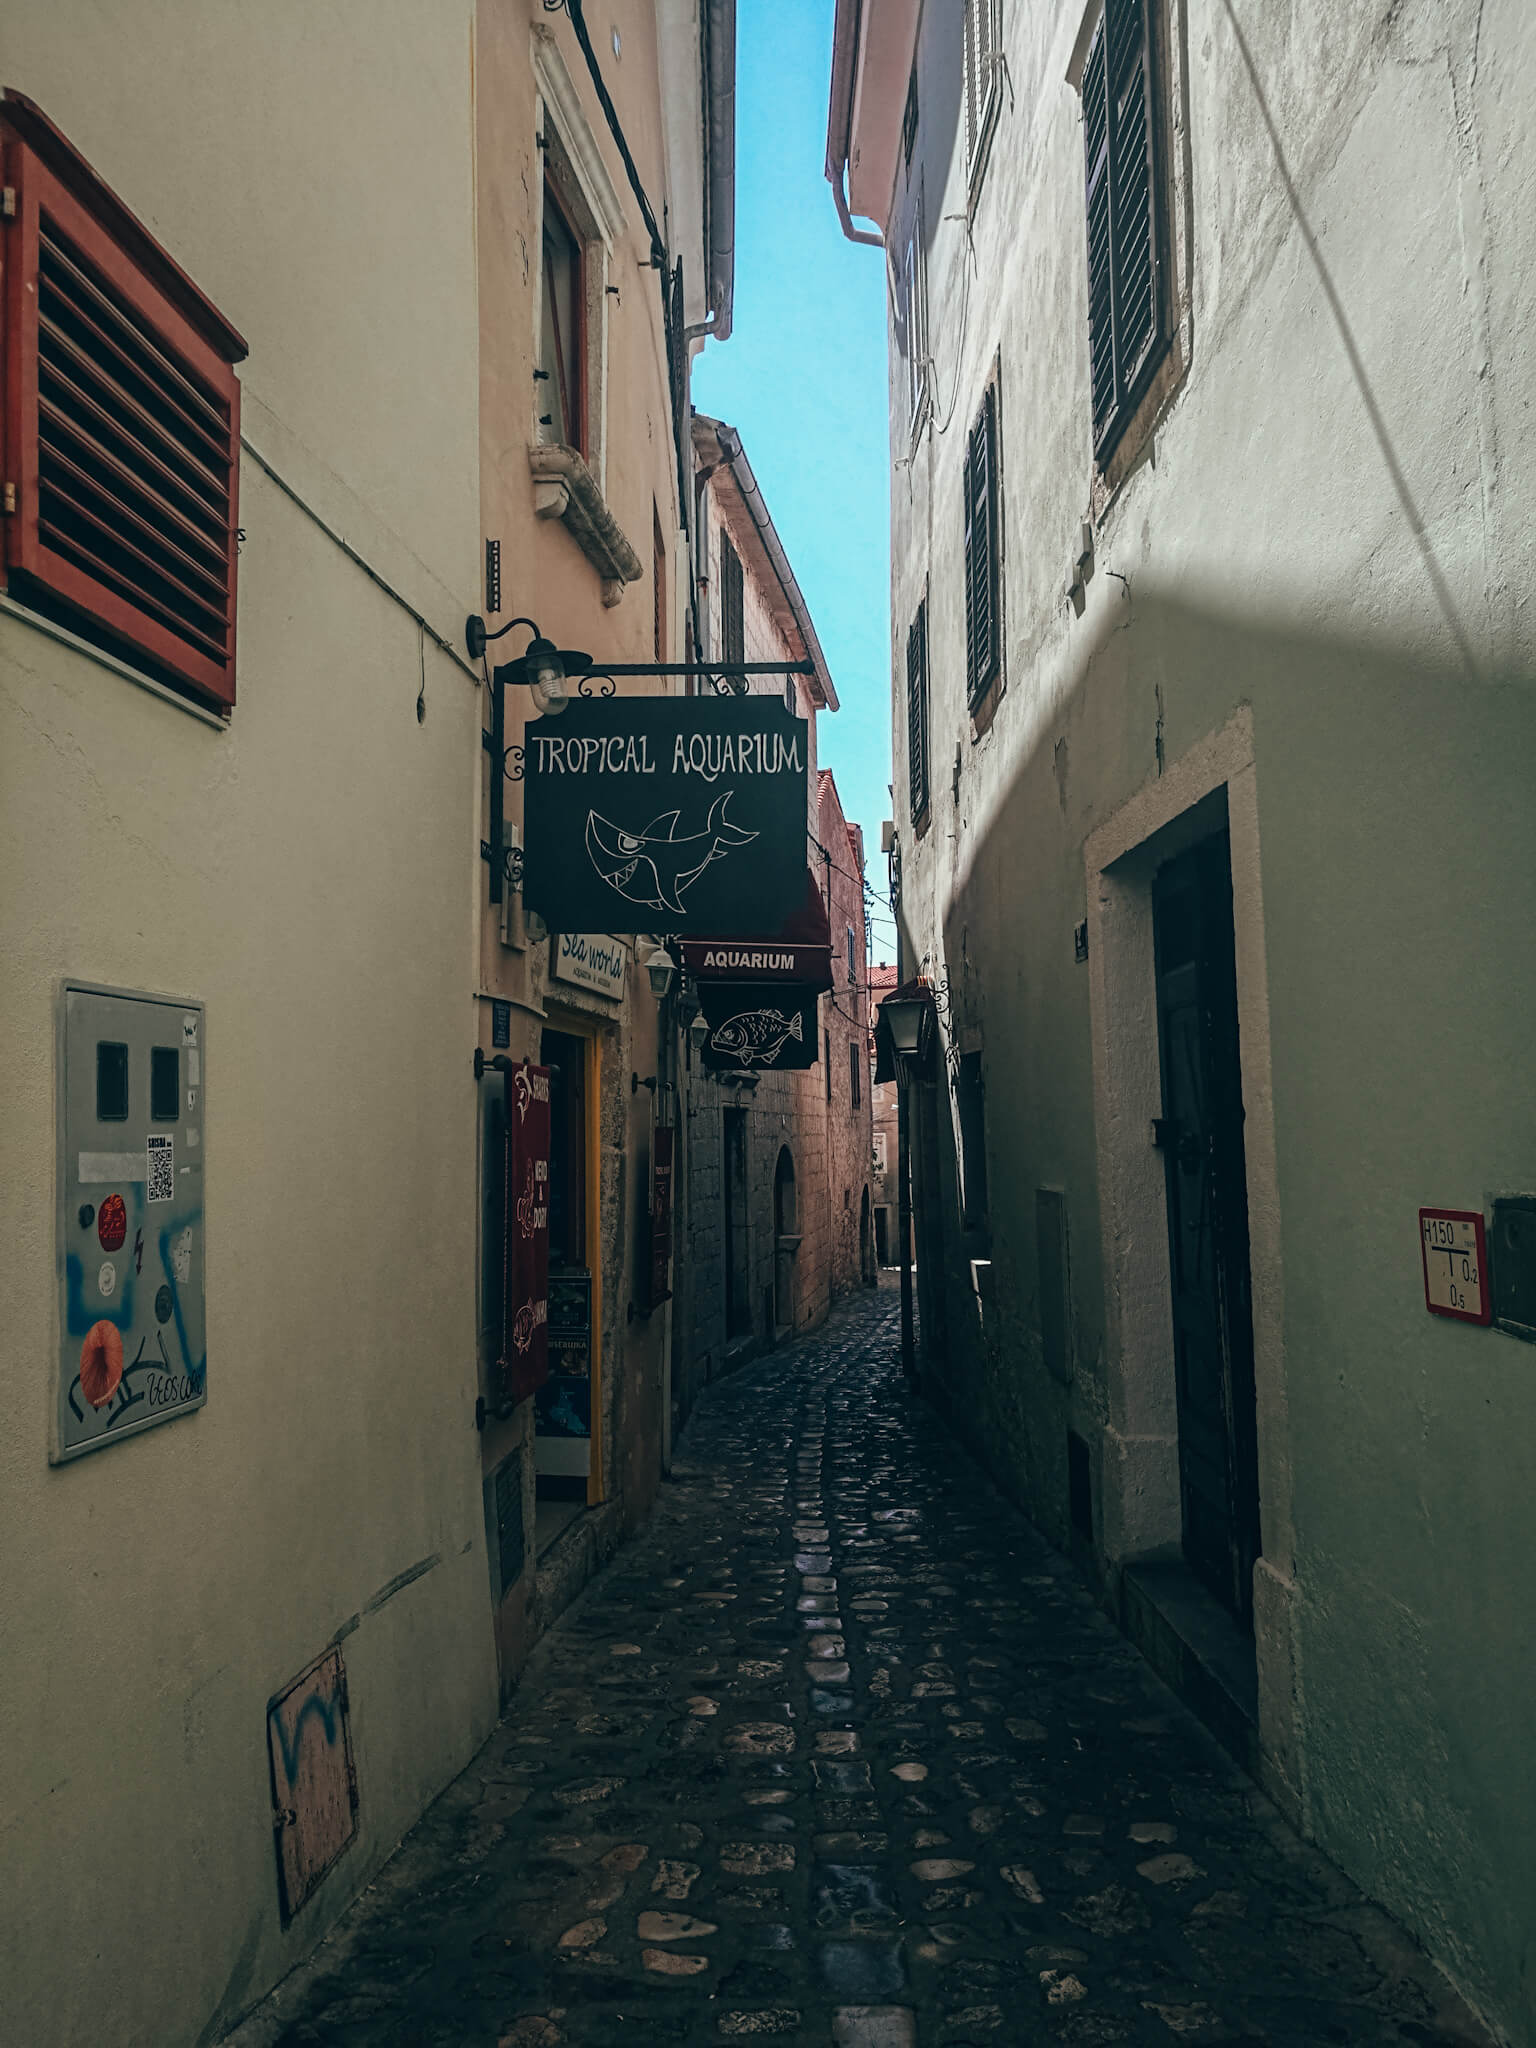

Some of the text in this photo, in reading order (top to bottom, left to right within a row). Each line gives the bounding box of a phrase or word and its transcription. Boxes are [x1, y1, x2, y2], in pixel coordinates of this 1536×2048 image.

[531, 733, 804, 782] TROPICAL AQUARIUM
[562, 934, 623, 979] Sea world
[703, 951, 795, 970] AQUARIUM
[1423, 1220, 1454, 1244] H150
[1462, 1259, 1478, 1283] 0.2
[1450, 1284, 1465, 1309] 0.5
